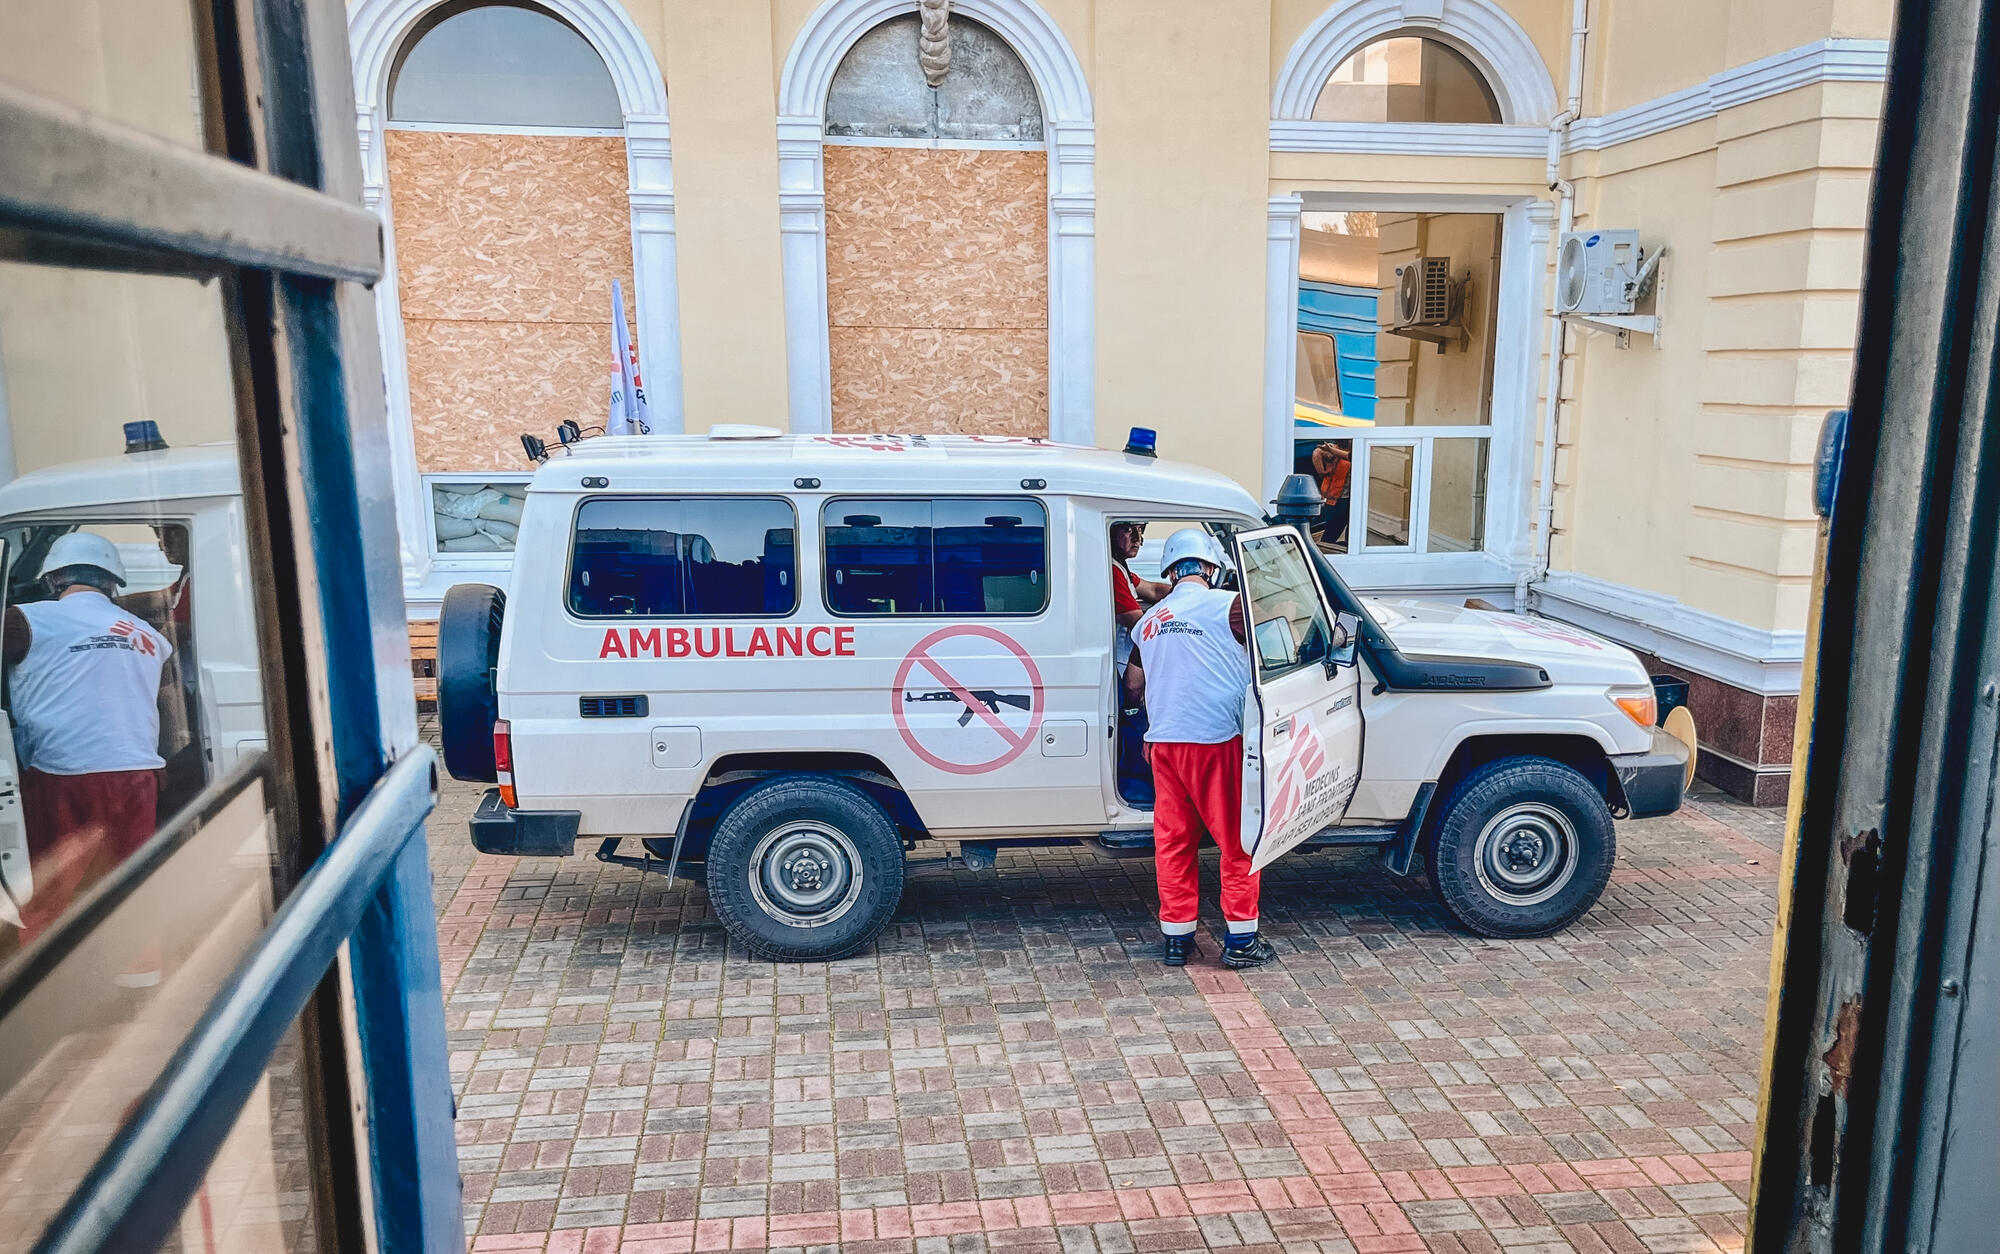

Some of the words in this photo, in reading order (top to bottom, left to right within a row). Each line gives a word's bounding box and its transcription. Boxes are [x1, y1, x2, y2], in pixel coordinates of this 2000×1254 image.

[1161, 621, 1188, 629] MEDECINS
[1169, 627, 1203, 636] FRONTIERES
[600, 626, 855, 658] AMBULANCE
[1303, 765, 1340, 799] MEDECINS
[1295, 796, 1317, 822] SANS
